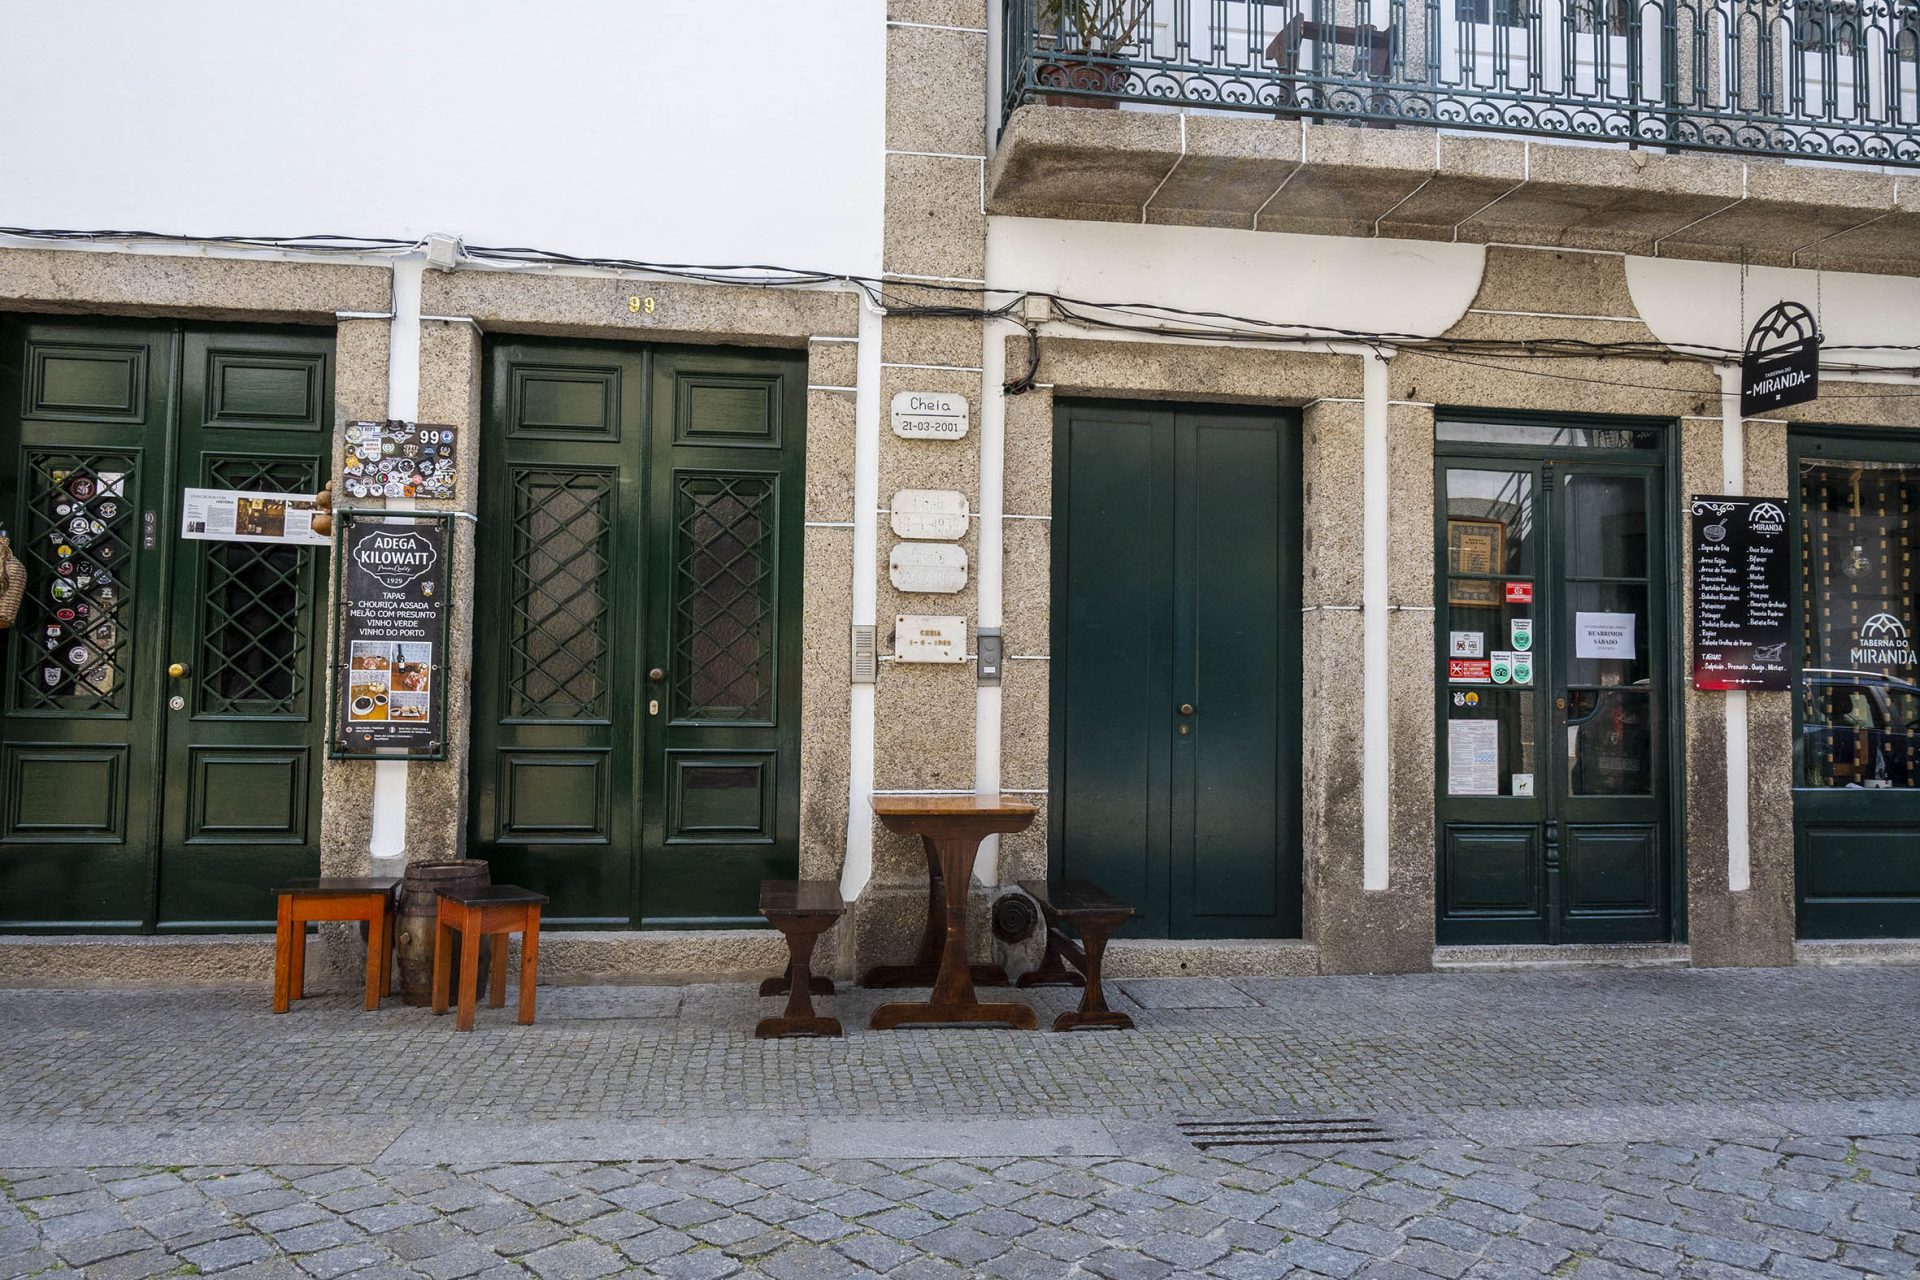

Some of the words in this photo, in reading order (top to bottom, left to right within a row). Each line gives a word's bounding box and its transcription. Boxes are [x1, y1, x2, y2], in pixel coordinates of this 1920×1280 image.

[629, 296, 655, 314] 99
[910, 396, 952, 411] Cheia
[902, 420, 958, 433] 21-03-2001
[419, 430, 439, 444] 99
[374, 537, 417, 550] ADEGA
[1701, 543, 1713, 553] Sopa
[1721, 544, 1730, 552] Dia
[361, 550, 429, 565] KILOWATT
[1721, 566, 1737, 574] Tomate
[1701, 575, 1727, 583] Francesinha
[382, 592, 406, 600] TAPAS
[358, 600, 398, 610] CHOURIÇA
[350, 608, 376, 617] MELÃO
[396, 610, 436, 619] PRESUNTO
[366, 619, 392, 627] VINHO
[393, 619, 419, 627] VERDE
[359, 628, 385, 636] VINHO
[399, 629, 425, 637] PORTO
[1593, 637, 1618, 645] SÁBADO
[1859, 639, 1895, 647] TABERNA
[1896, 639, 1909, 647] DO
[1850, 648, 1918, 665] MIRANDA
